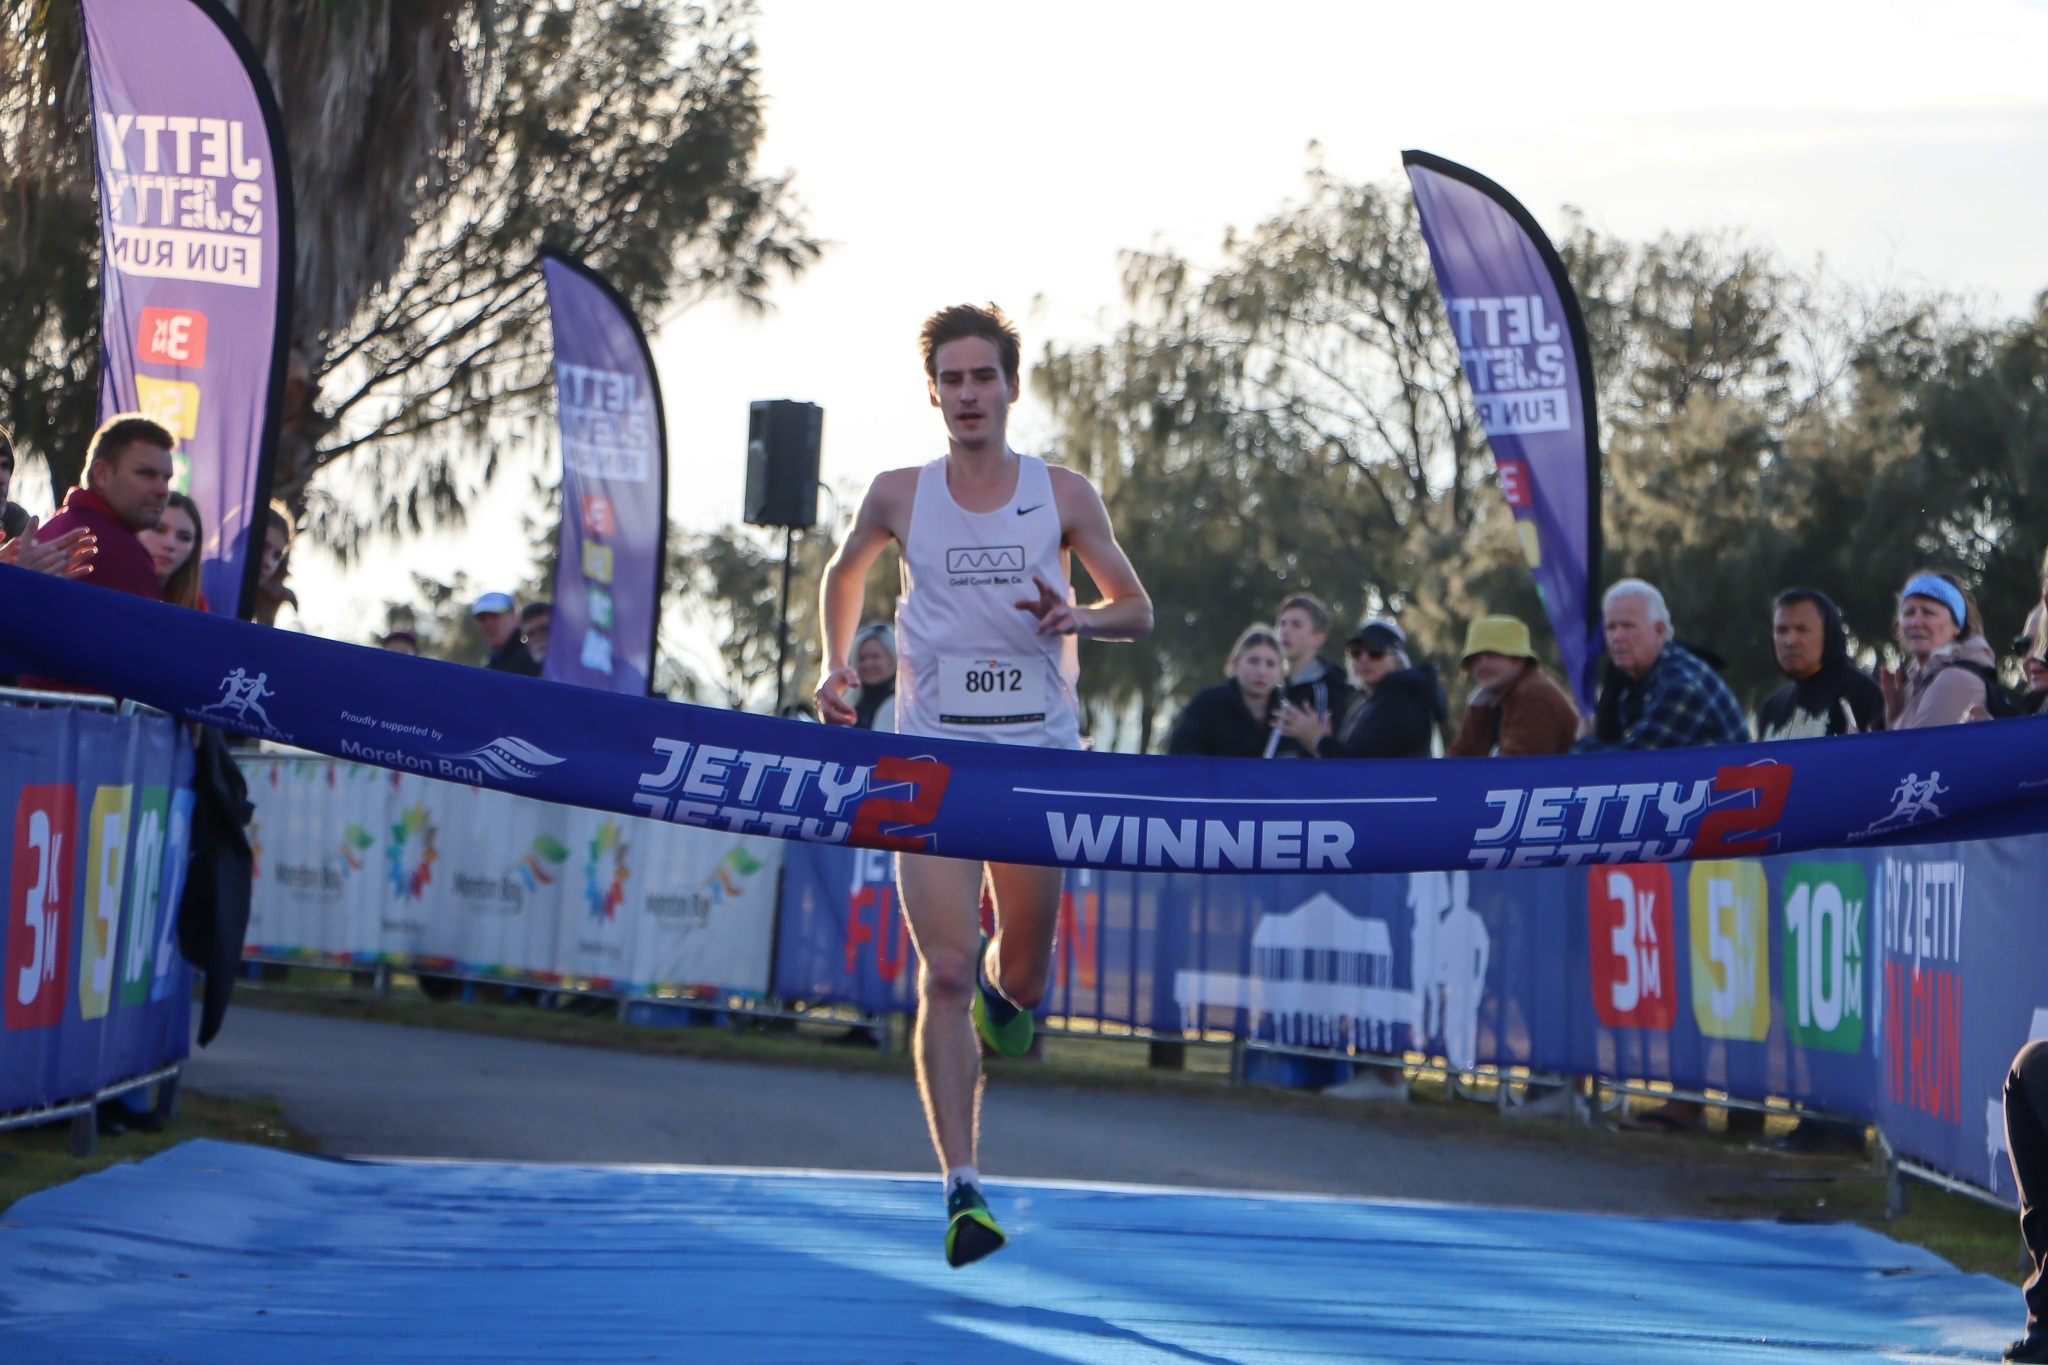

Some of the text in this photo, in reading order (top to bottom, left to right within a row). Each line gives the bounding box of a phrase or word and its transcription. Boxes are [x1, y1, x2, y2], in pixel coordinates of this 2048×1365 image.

[993, 575, 1010, 585] Run
[966, 668, 1023, 693] 8012
[341, 711, 443, 741] Proudly supported by
[341, 738, 483, 785] Moreton Bay
[637, 737, 951, 850] JETTY 2
[1474, 763, 1794, 859] JETTY 2
[1046, 811, 1355, 870] WINNER
[1914, 861, 1965, 982] JETTY
[1910, 966, 1962, 1127] RUN
